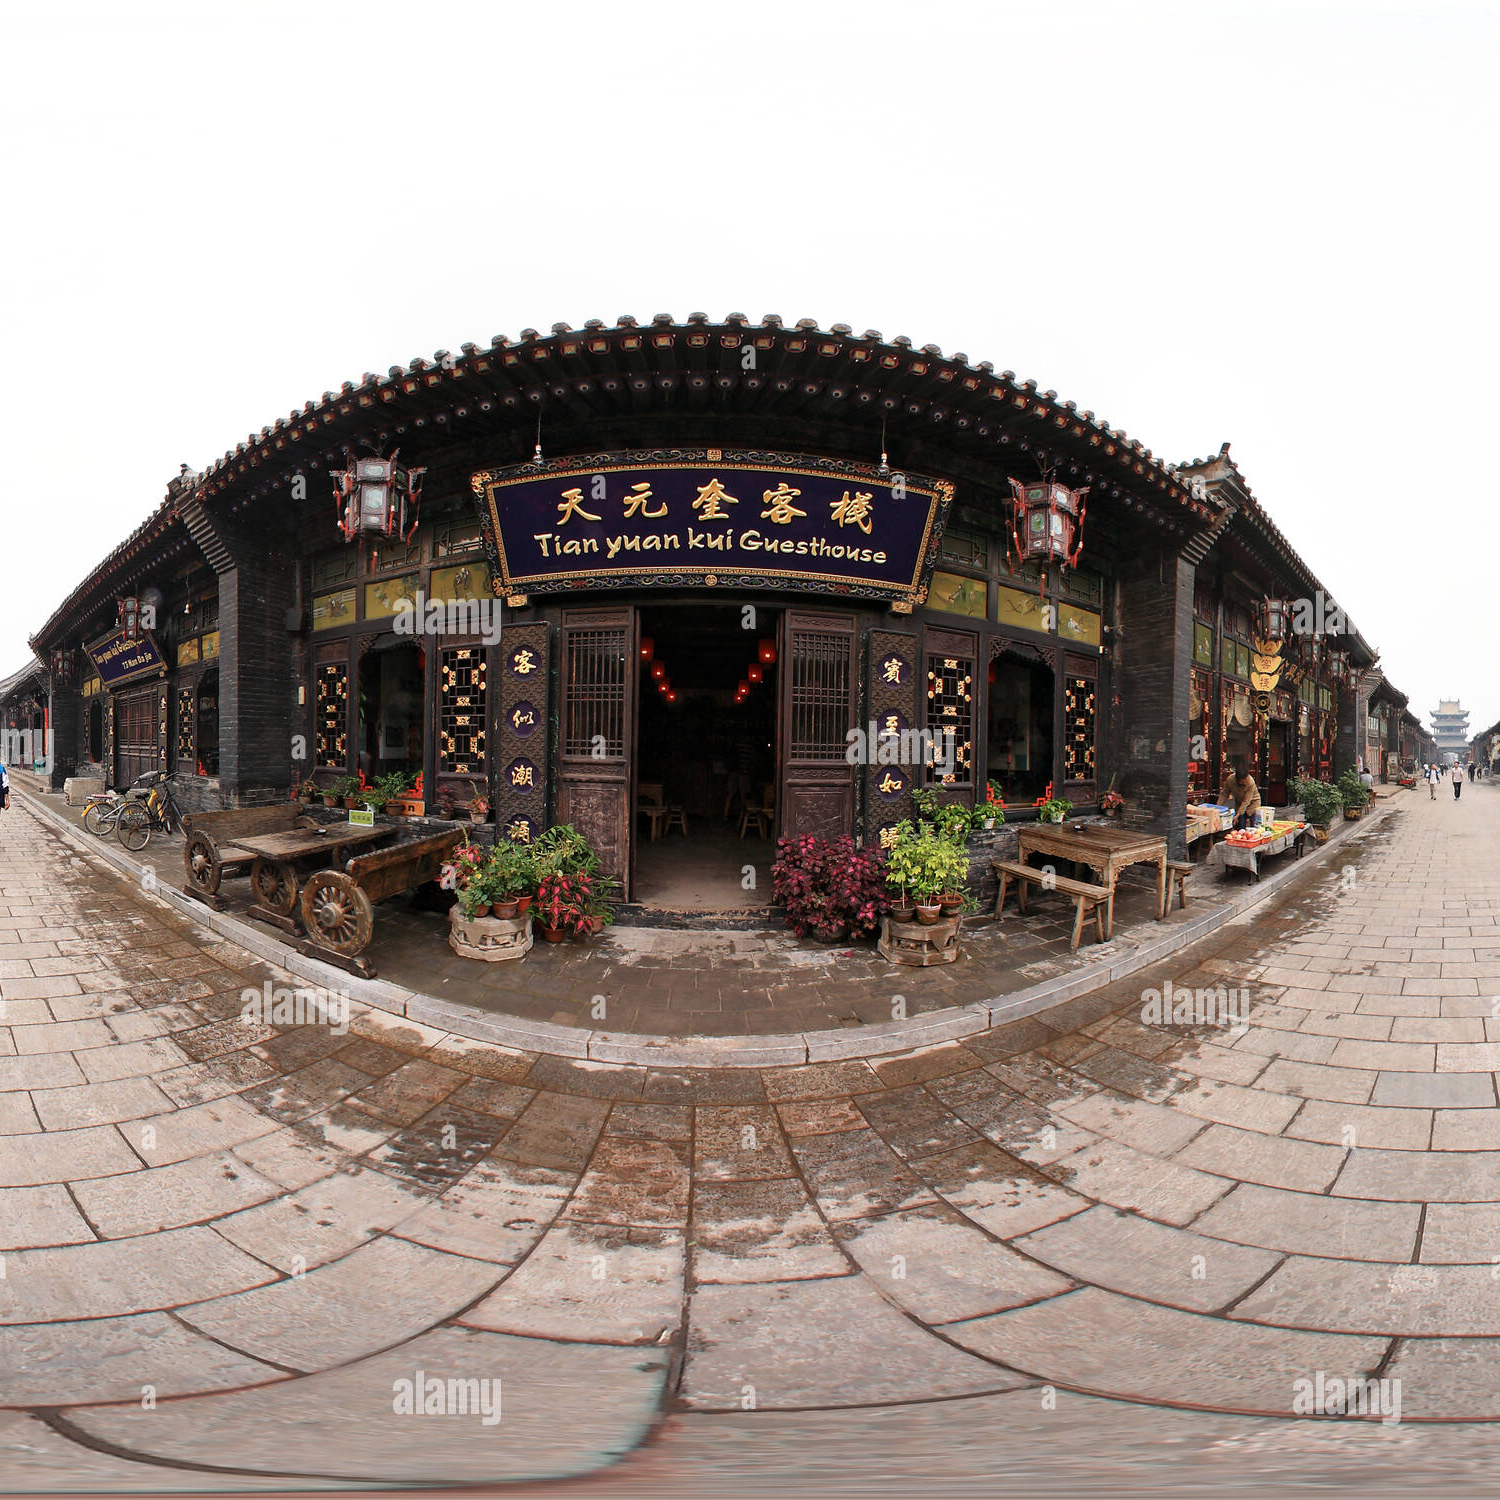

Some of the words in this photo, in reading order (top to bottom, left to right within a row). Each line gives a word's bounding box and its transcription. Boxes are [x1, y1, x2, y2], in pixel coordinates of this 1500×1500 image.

[534, 533, 599, 557] Tian
[606, 534, 680, 559] yuan
[687, 527, 733, 550] kui
[739, 530, 887, 563] Guesthouse
